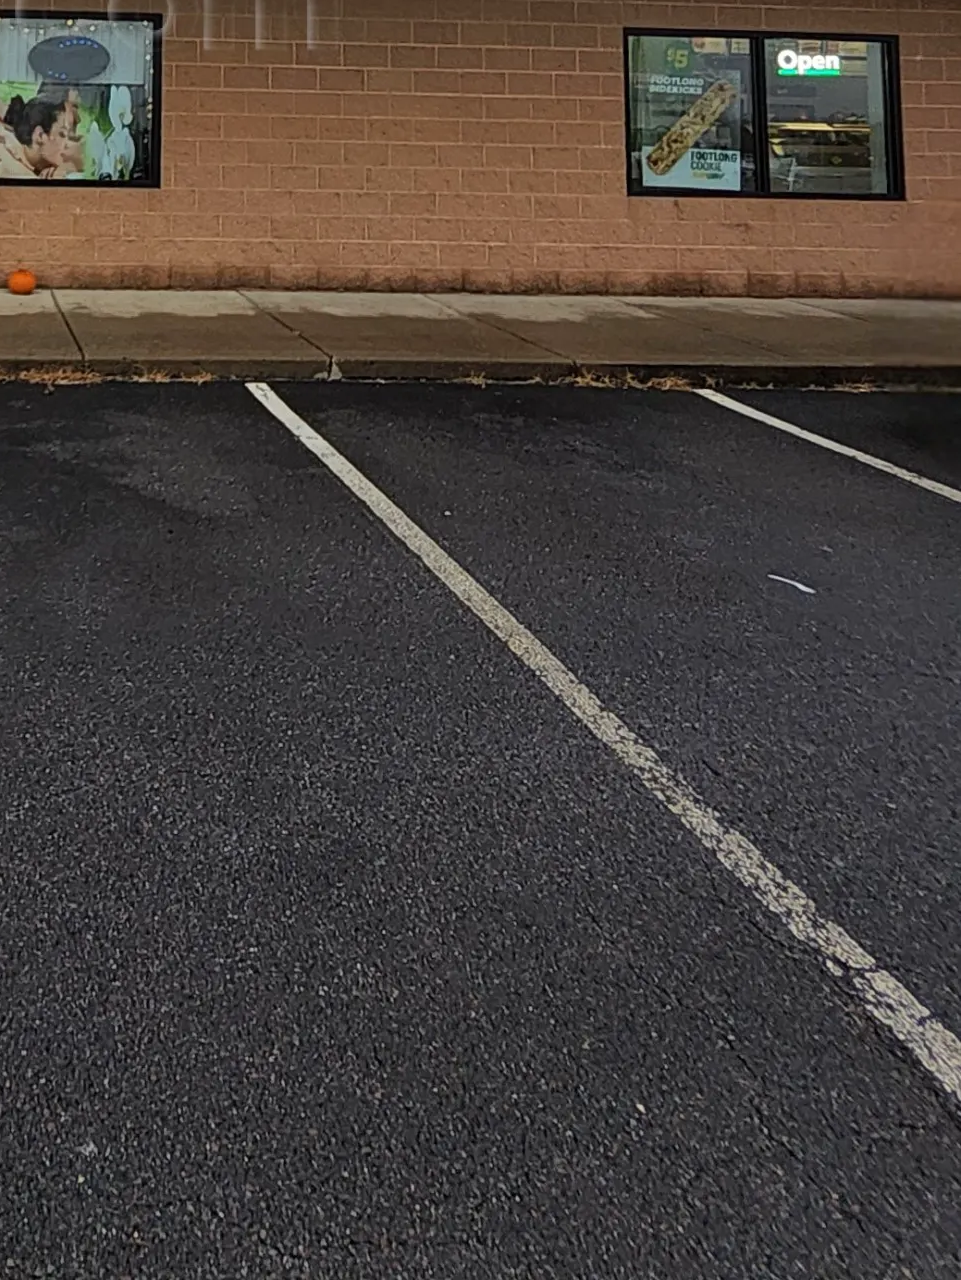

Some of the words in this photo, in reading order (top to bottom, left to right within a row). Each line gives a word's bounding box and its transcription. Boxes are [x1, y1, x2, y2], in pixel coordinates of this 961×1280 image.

[777, 49, 841, 76] Open
[691, 151, 737, 163] FOOTLONG
[690, 161, 722, 172] COOKIE
